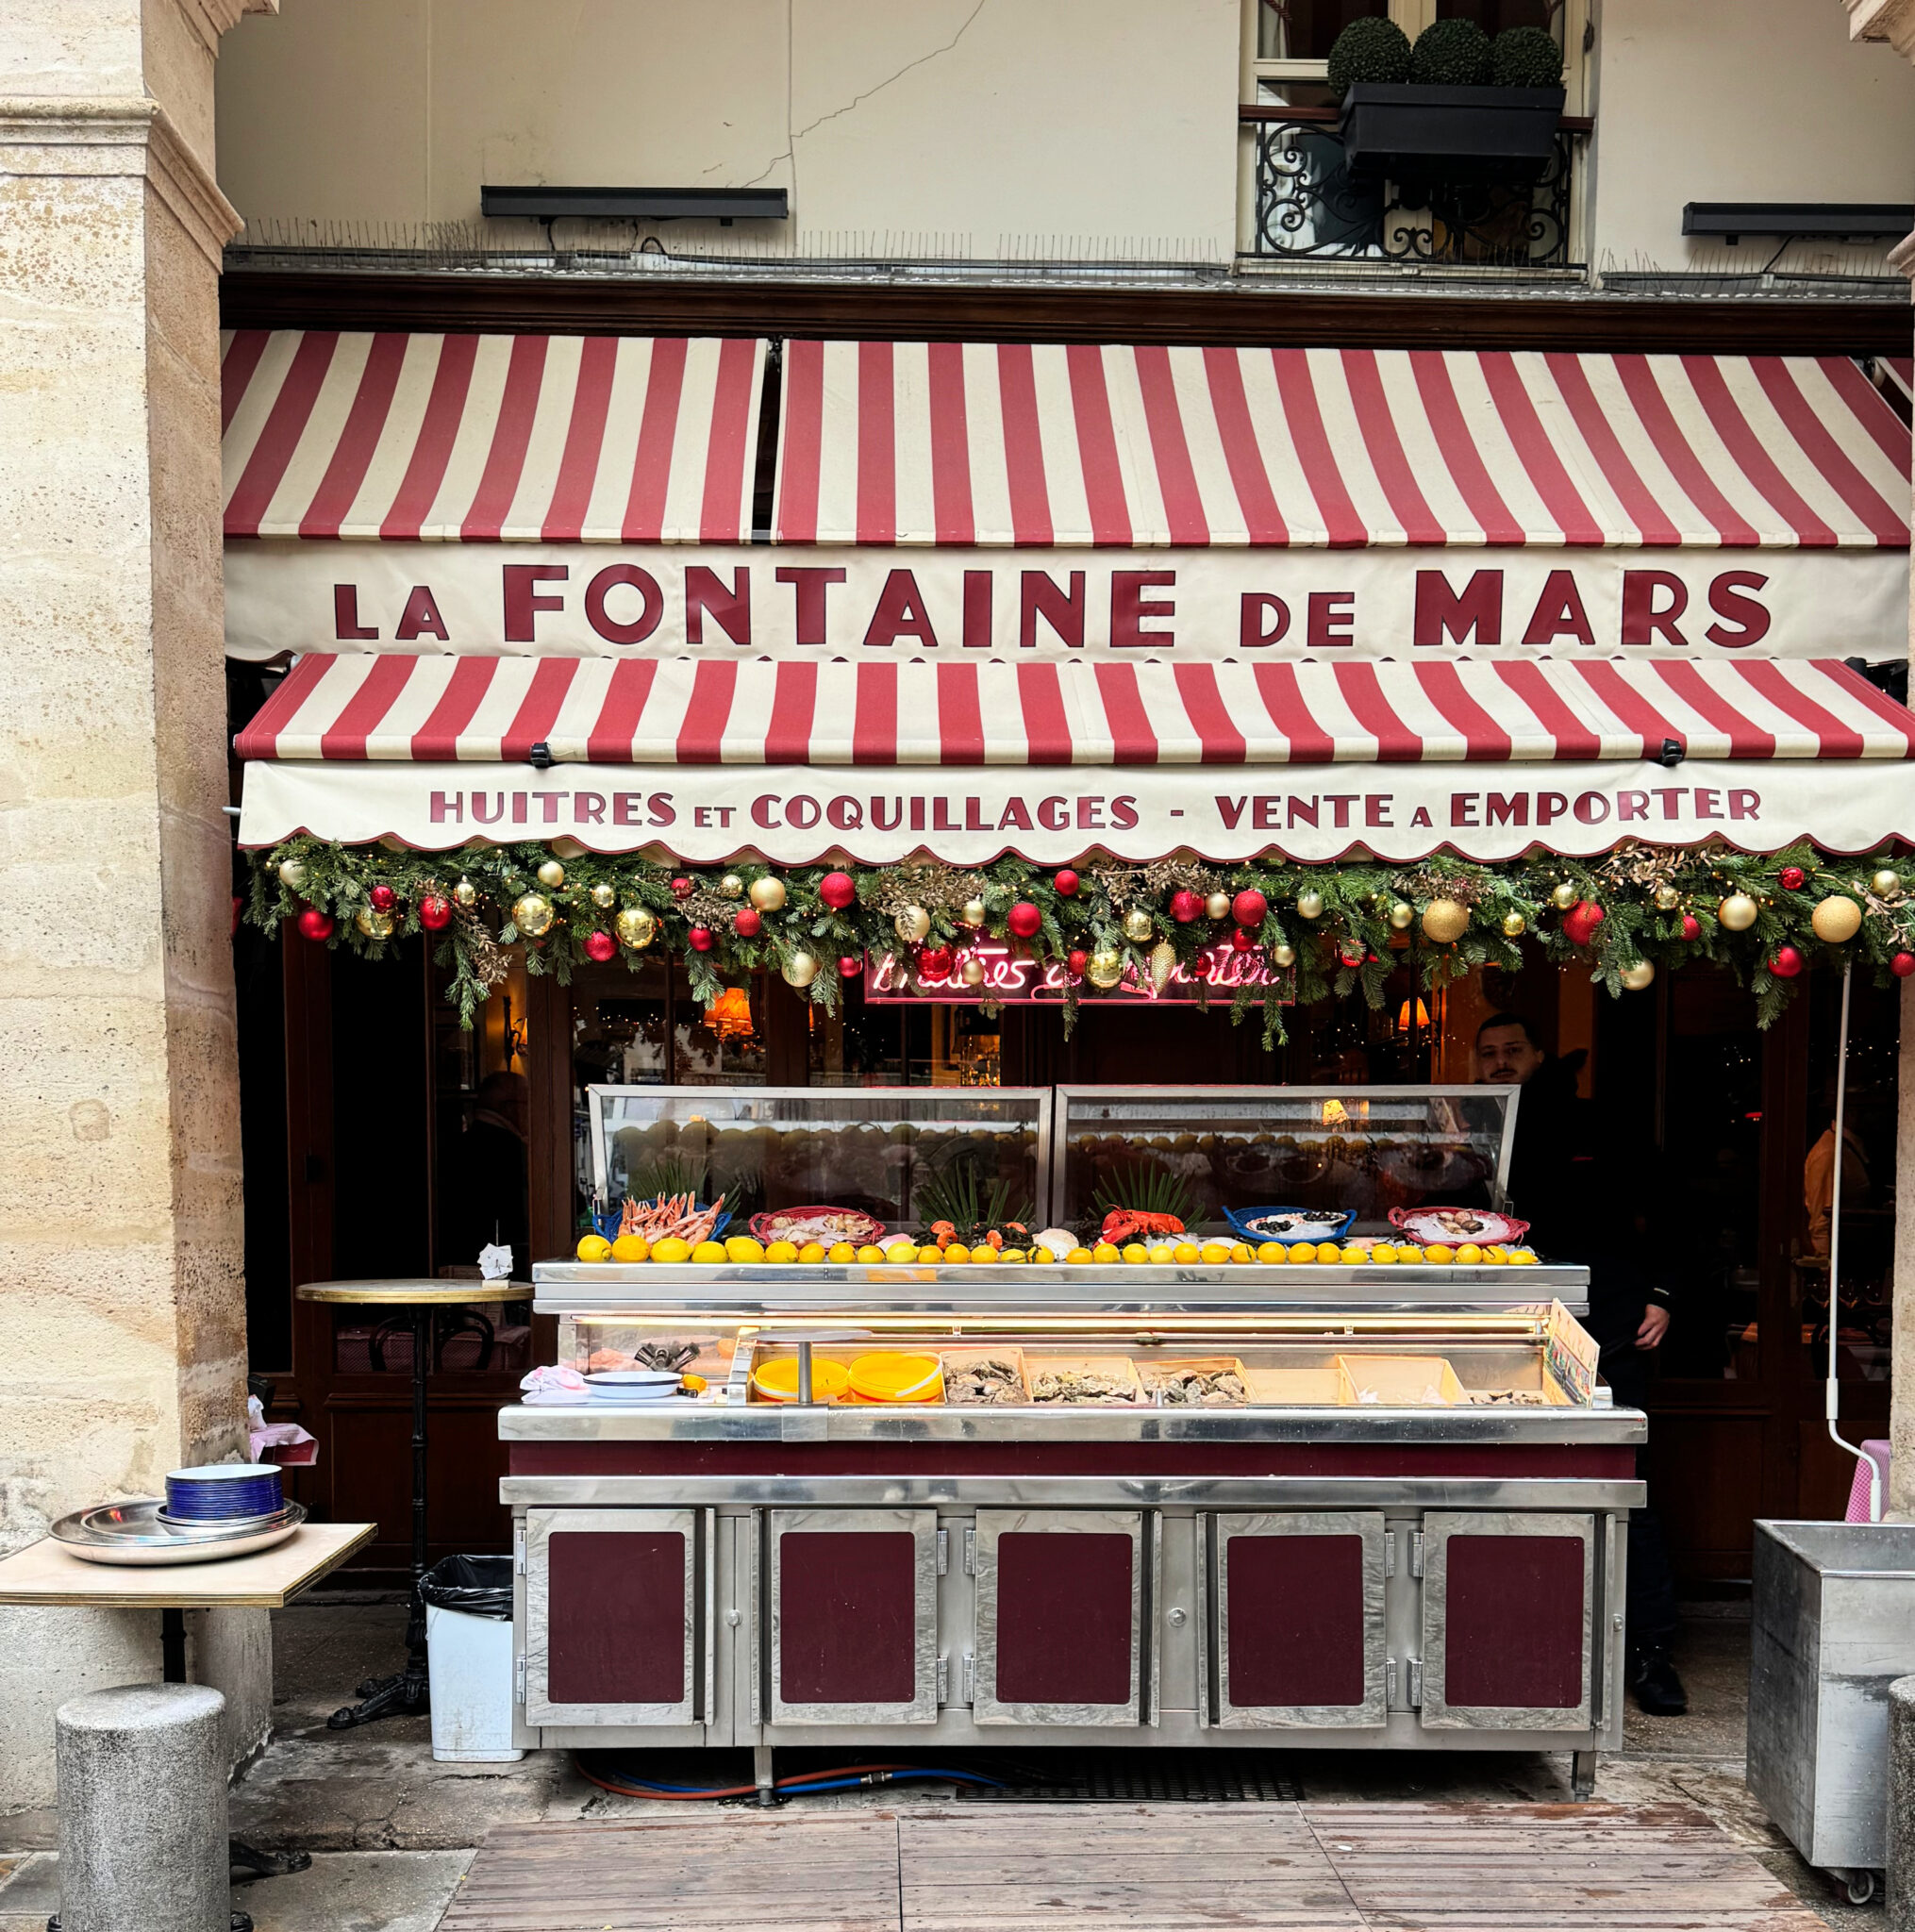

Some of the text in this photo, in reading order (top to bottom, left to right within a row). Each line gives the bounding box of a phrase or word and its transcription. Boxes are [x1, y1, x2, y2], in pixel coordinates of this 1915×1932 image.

[334, 564, 1772, 648] LA FONTAINE DE MARS
[430, 791, 676, 826] HUITRES
[694, 806, 737, 828] ET
[751, 794, 1140, 831] COQUILLAGES
[1215, 794, 1394, 830] VENTE
[1410, 806, 1434, 828] A
[1451, 787, 1761, 827] EMPORTER
